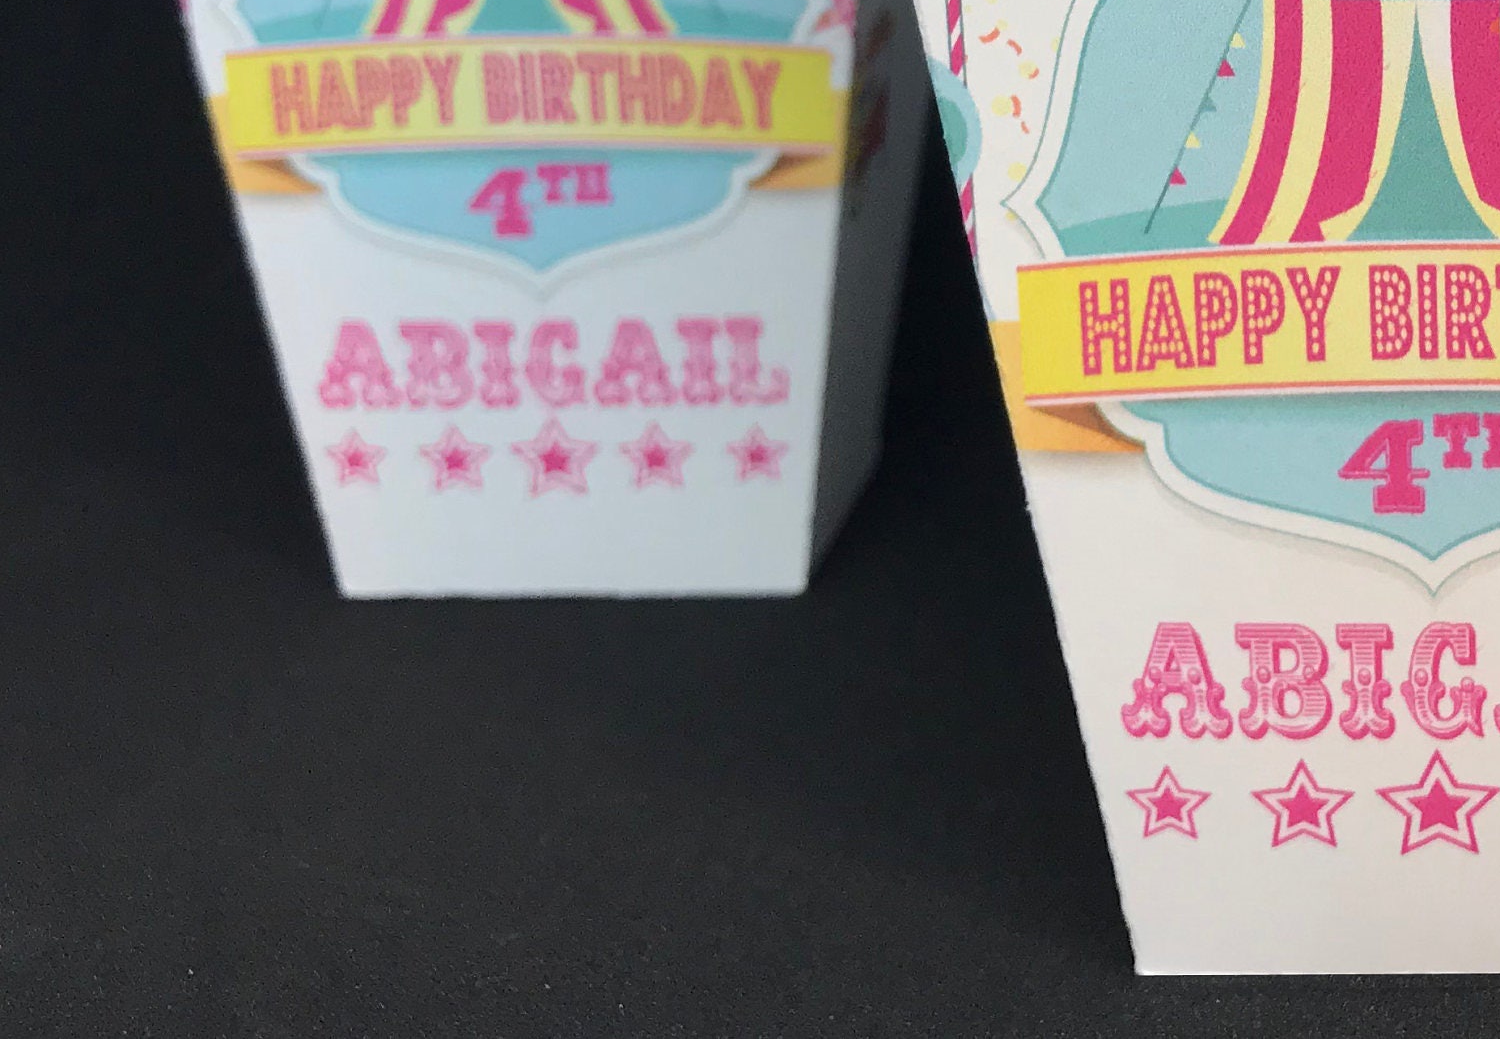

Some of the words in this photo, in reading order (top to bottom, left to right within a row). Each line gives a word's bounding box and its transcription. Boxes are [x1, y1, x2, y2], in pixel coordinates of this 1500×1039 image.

[269, 54, 460, 136] HAPPY
[482, 51, 782, 130] BIRTHDAY
[468, 164, 614, 237] 4TH
[318, 314, 791, 409] ABIGAIL
[1078, 265, 1342, 376] HAPPY
